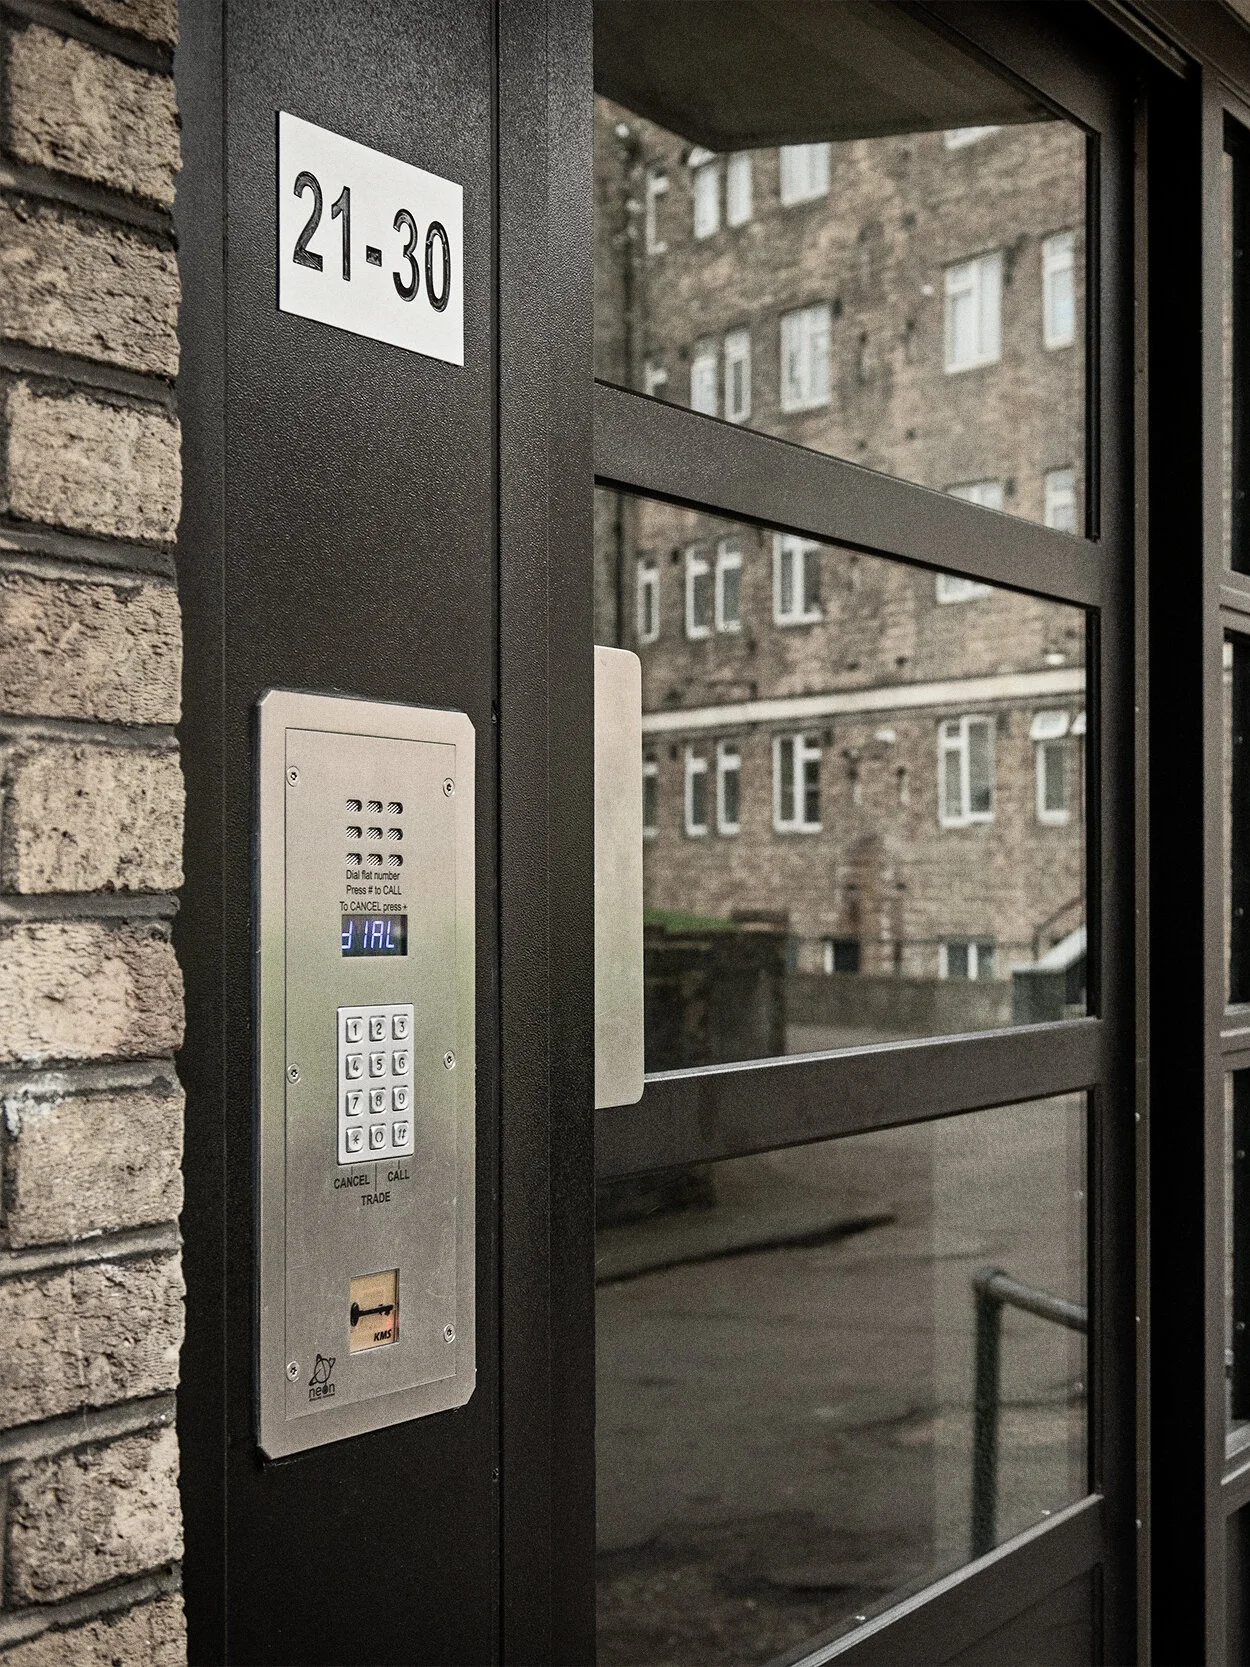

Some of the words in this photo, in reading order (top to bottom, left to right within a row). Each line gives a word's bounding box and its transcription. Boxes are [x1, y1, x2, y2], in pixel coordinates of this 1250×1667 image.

[293, 170, 450, 312] 21-30
[346, 869, 360, 880] Dial
[361, 869, 373, 880] flat
[374, 871, 400, 880] number
[346, 884, 366, 895] Press
[374, 886, 381, 895] to
[383, 885, 402, 895] CALL
[339, 901, 348, 911] To
[350, 901, 381, 911] CANCEL
[383, 903, 401, 913] press
[353, 1023, 358, 1036] 1
[375, 1022, 382, 1036] 2
[399, 1021, 405, 1033] 3
[352, 1060, 359, 1072] 4
[376, 1058, 382, 1071] 5
[398, 1057, 405, 1069] 6
[353, 1097, 359, 1110] 7
[375, 1095, 382, 1107] 8
[398, 1092, 405, 1104] 9
[375, 1131, 383, 1143] 0
[333, 1174, 371, 1189] CANCEL
[387, 1169, 410, 1182] CALL
[361, 1191, 391, 1206] TRADE
[373, 1328, 392, 1342] KMS
[308, 1383, 336, 1398] neon
